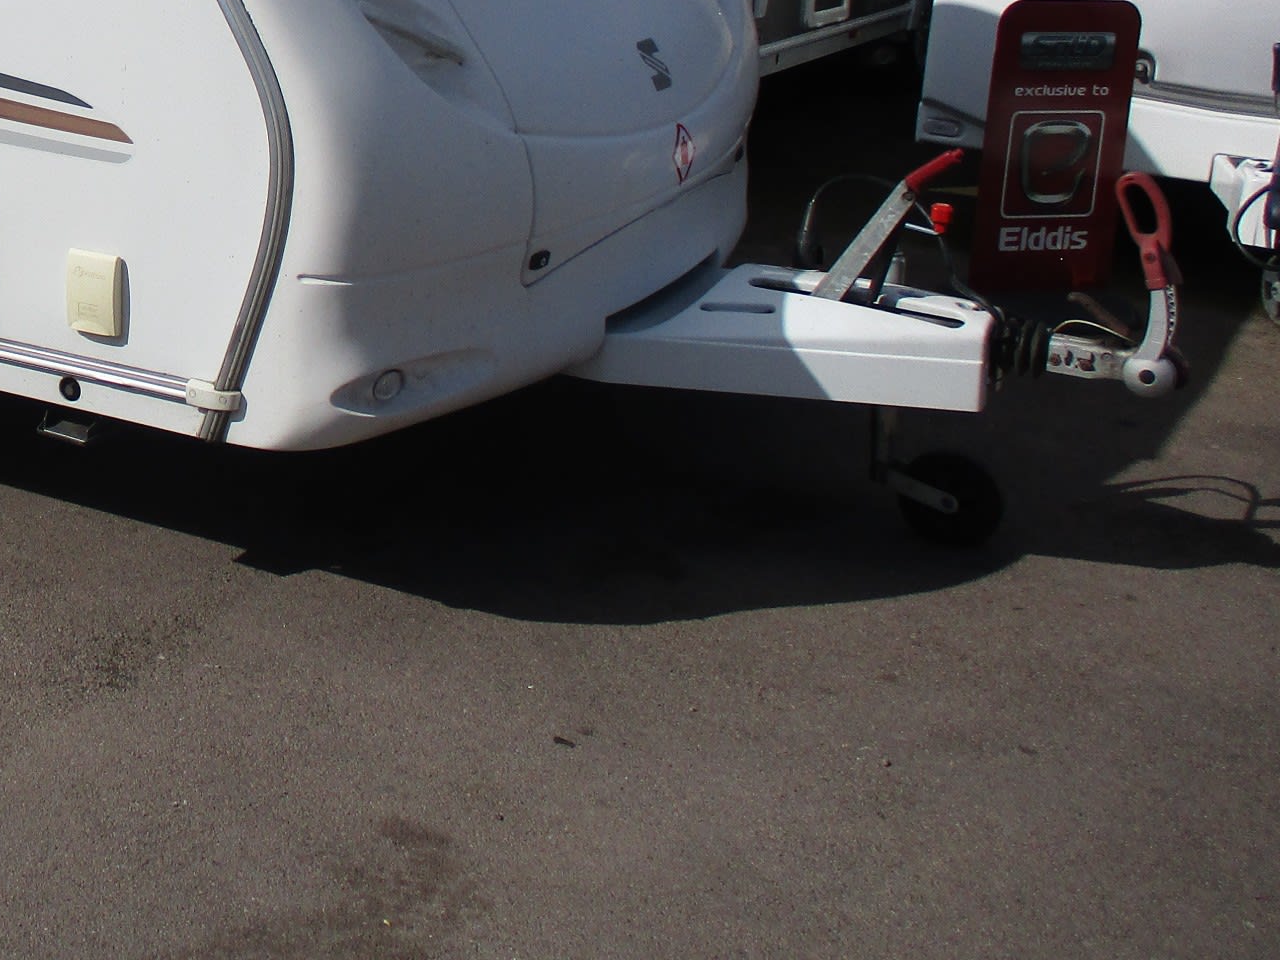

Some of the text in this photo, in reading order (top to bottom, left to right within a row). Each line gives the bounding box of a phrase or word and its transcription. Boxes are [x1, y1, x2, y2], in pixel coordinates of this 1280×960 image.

[1014, 84, 1110, 97] exclusive to
[998, 225, 1089, 252] Elddis
